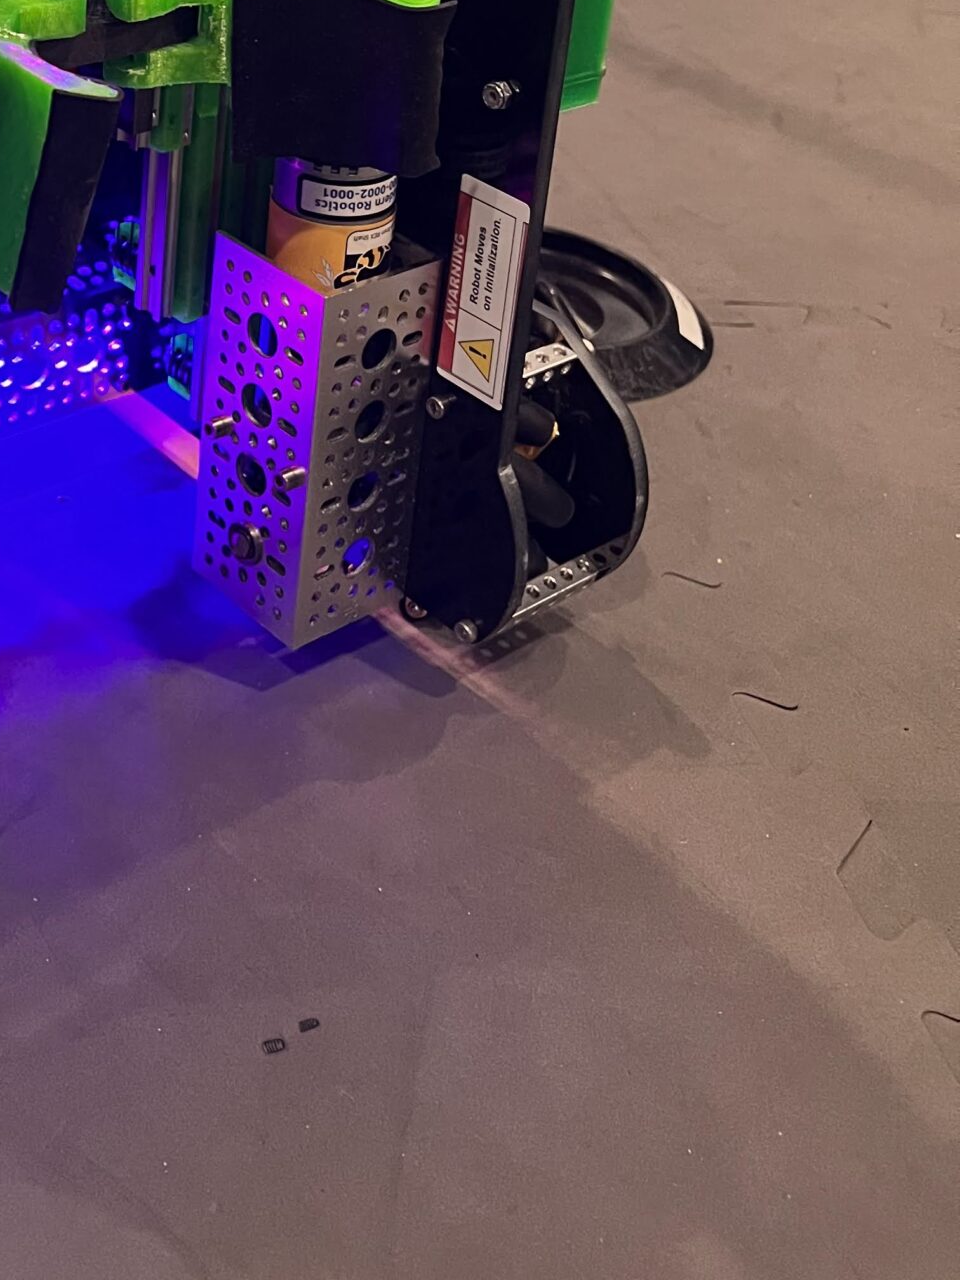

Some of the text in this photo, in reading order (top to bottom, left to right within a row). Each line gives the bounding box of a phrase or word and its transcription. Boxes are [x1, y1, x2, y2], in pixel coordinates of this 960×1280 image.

[314, 198, 372, 213] Robotics
[446, 233, 465, 315] WARNING
[469, 226, 487, 305] Robot Moves
[483, 218, 502, 311] on Initialization.
